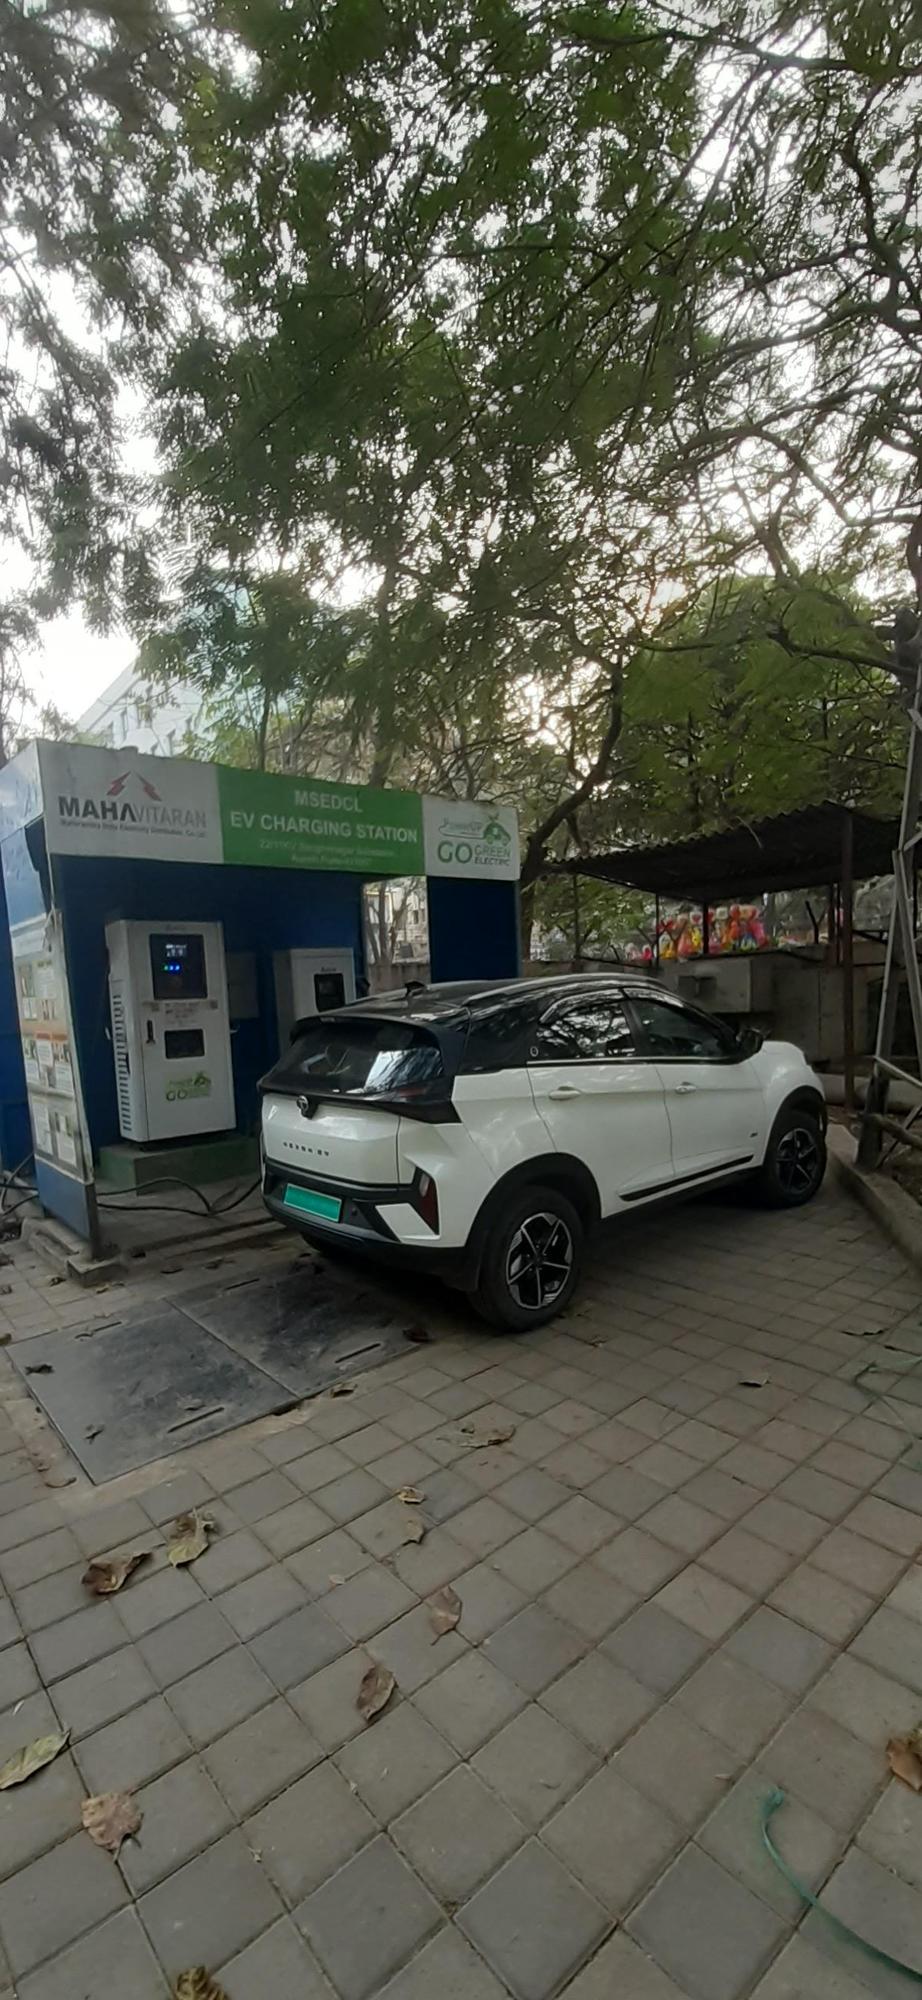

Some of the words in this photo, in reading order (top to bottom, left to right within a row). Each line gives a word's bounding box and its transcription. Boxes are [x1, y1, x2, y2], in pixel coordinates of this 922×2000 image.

[58, 796, 207, 828] MAHAVITARAN
[294, 789, 363, 813] MSEDCL
[230, 811, 255, 829] EV
[260, 814, 352, 838] CHARGING
[356, 824, 418, 843] STATION
[437, 841, 473, 864] GO
[474, 844, 511, 858] GREEN
